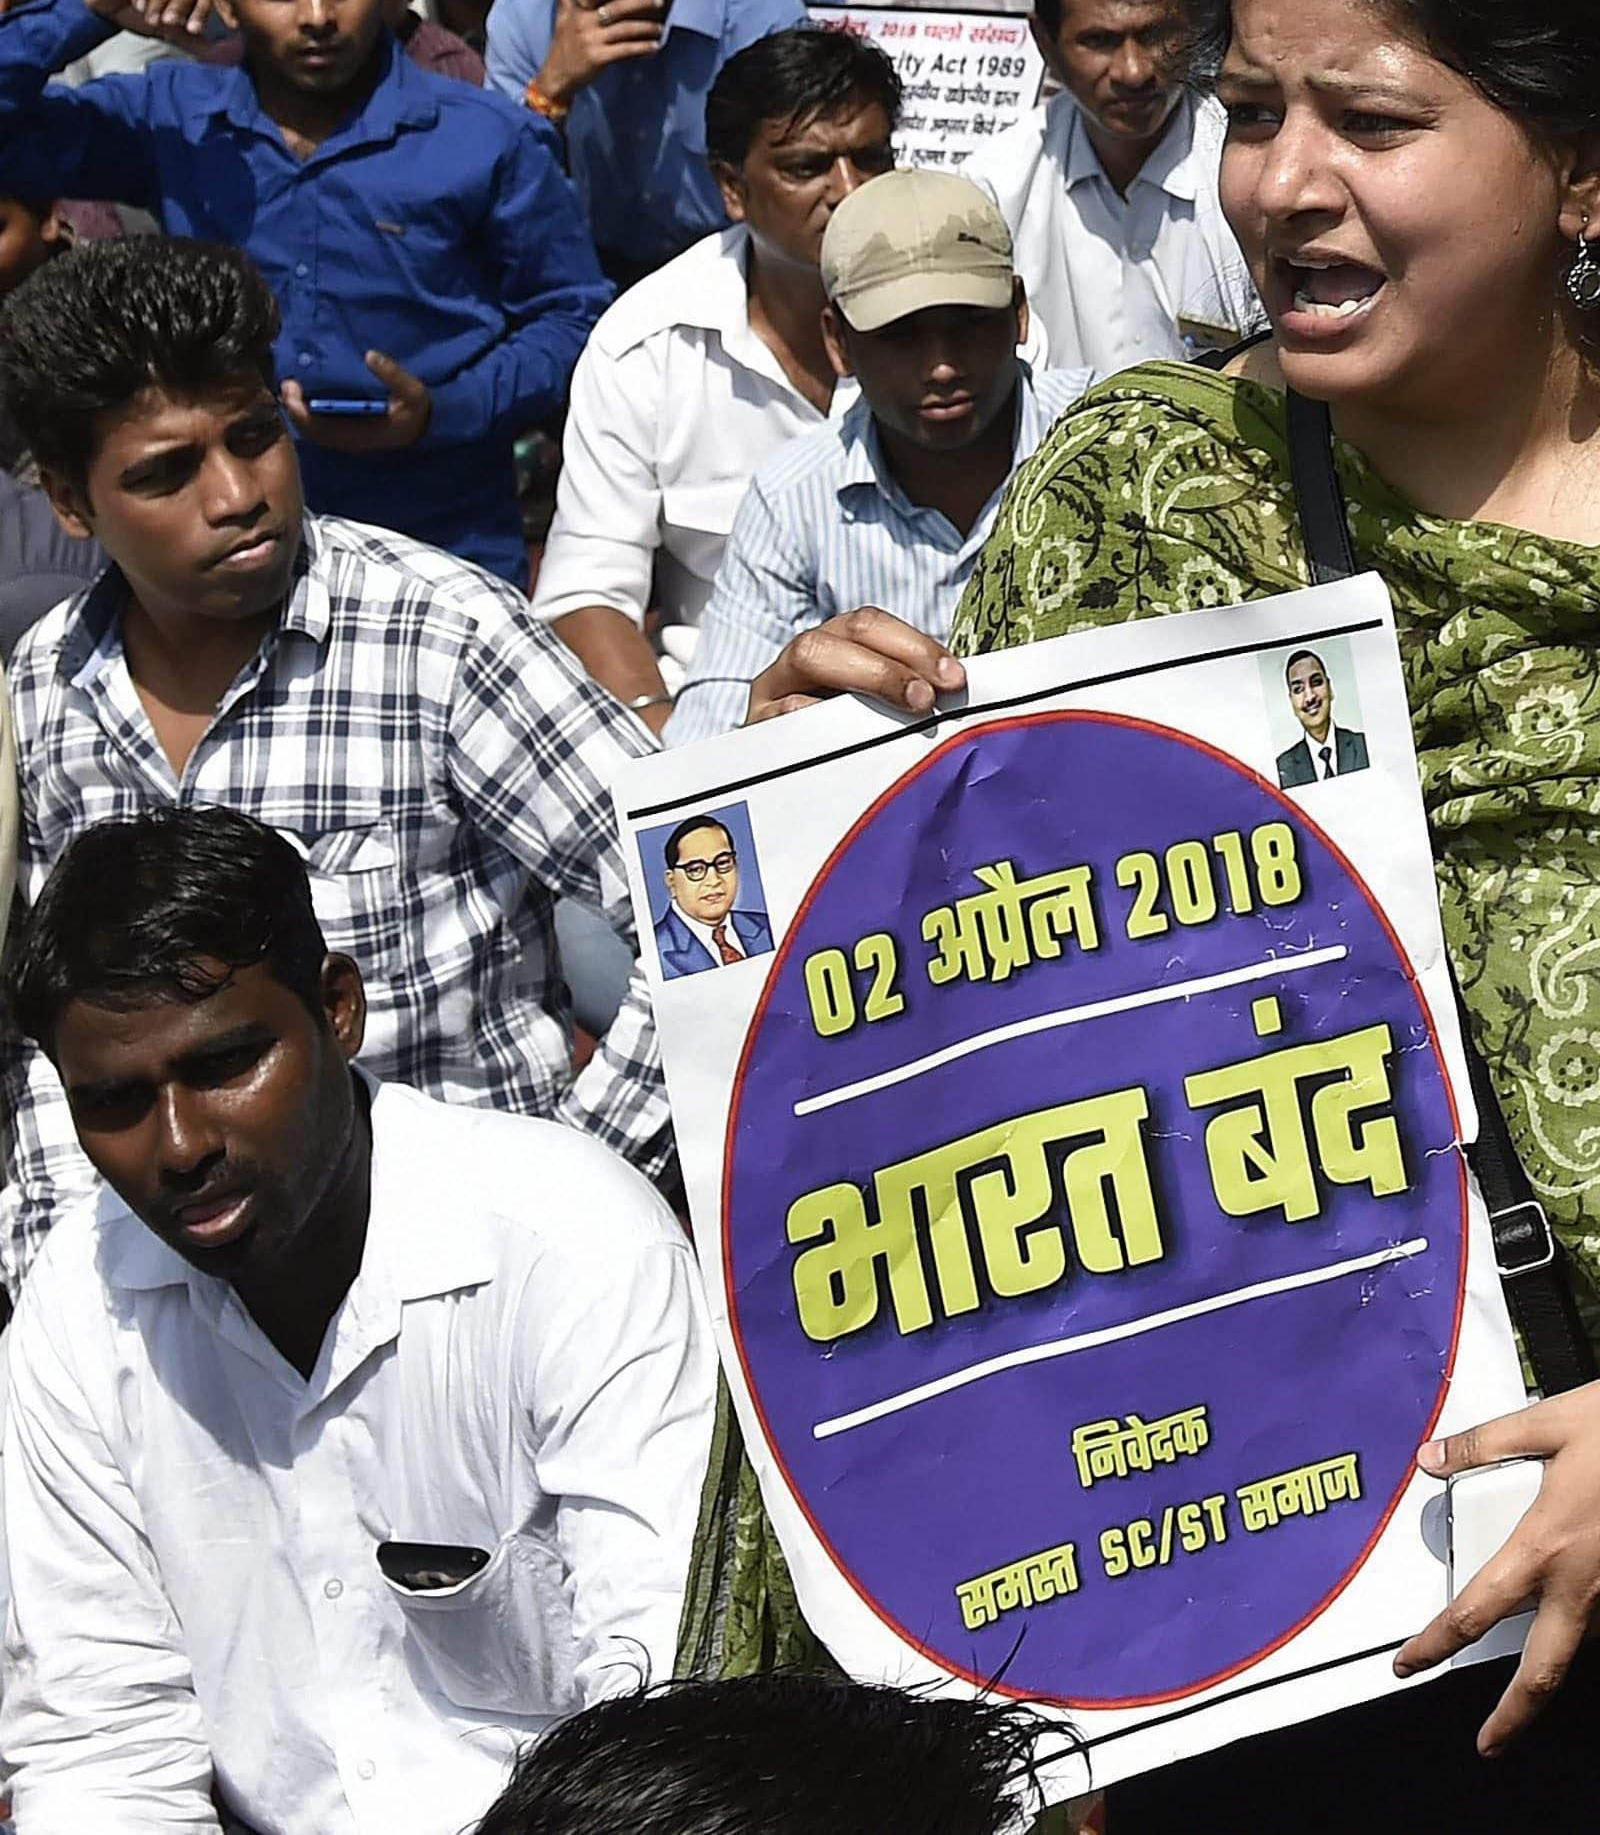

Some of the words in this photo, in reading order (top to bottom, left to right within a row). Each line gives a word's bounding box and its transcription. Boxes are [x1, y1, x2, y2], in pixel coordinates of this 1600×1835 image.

[930, 53, 967, 76] Act
[977, 54, 1026, 78] 1989
[804, 933, 904, 1037] 02
[921, 861, 1099, 985] अप्रैल
[1116, 822, 1302, 939] 2018
[787, 1086, 1166, 1344] भारत
[1184, 996, 1409, 1224] बंद
[1071, 1405, 1210, 1488] निवेदक
[955, 1543, 1079, 1631] समस्त
[1099, 1495, 1228, 1578] SC/ST
[1236, 1452, 1363, 1533] समाज
